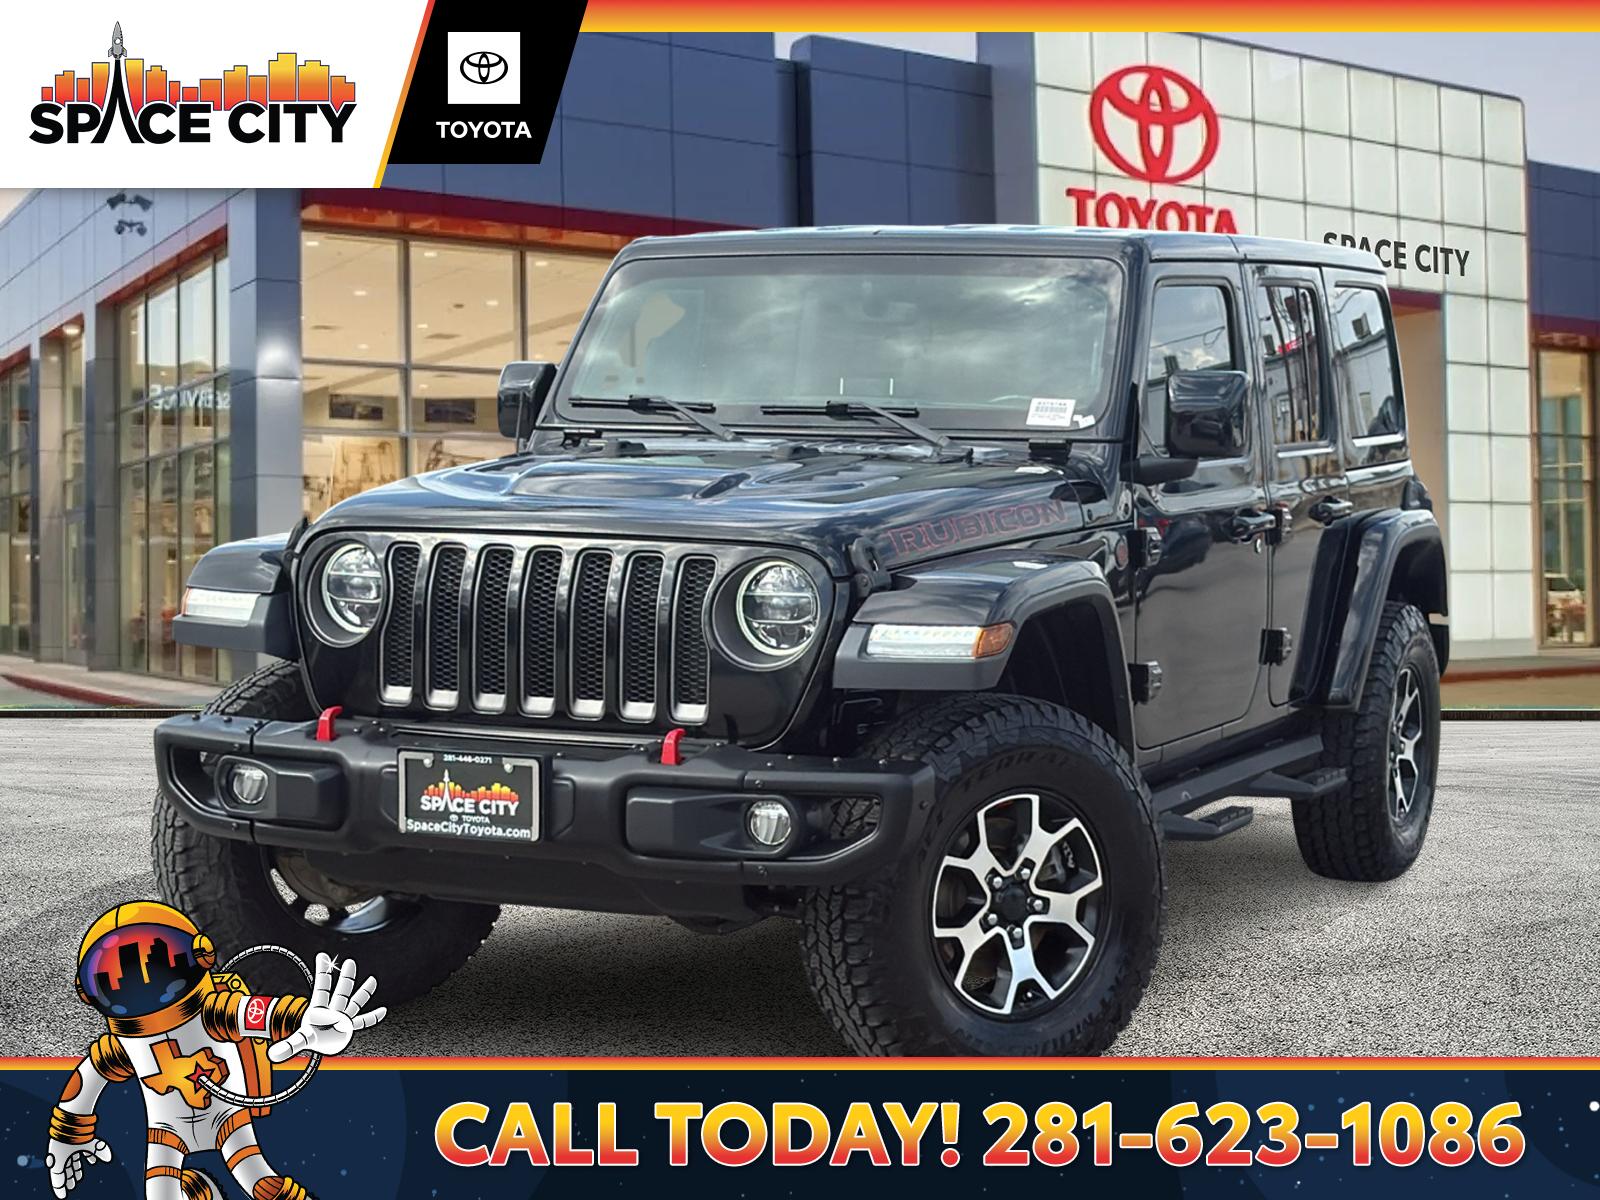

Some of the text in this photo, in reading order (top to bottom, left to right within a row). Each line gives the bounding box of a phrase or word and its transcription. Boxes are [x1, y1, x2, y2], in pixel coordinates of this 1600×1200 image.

[1414, 244, 1470, 277] CITY
[886, 499, 1067, 557] RUBICON
[420, 793, 519, 816] SPACE CITY
[406, 819, 531, 838] SpaceCityToyota.com
[461, 815, 490, 824] TOYOTA
